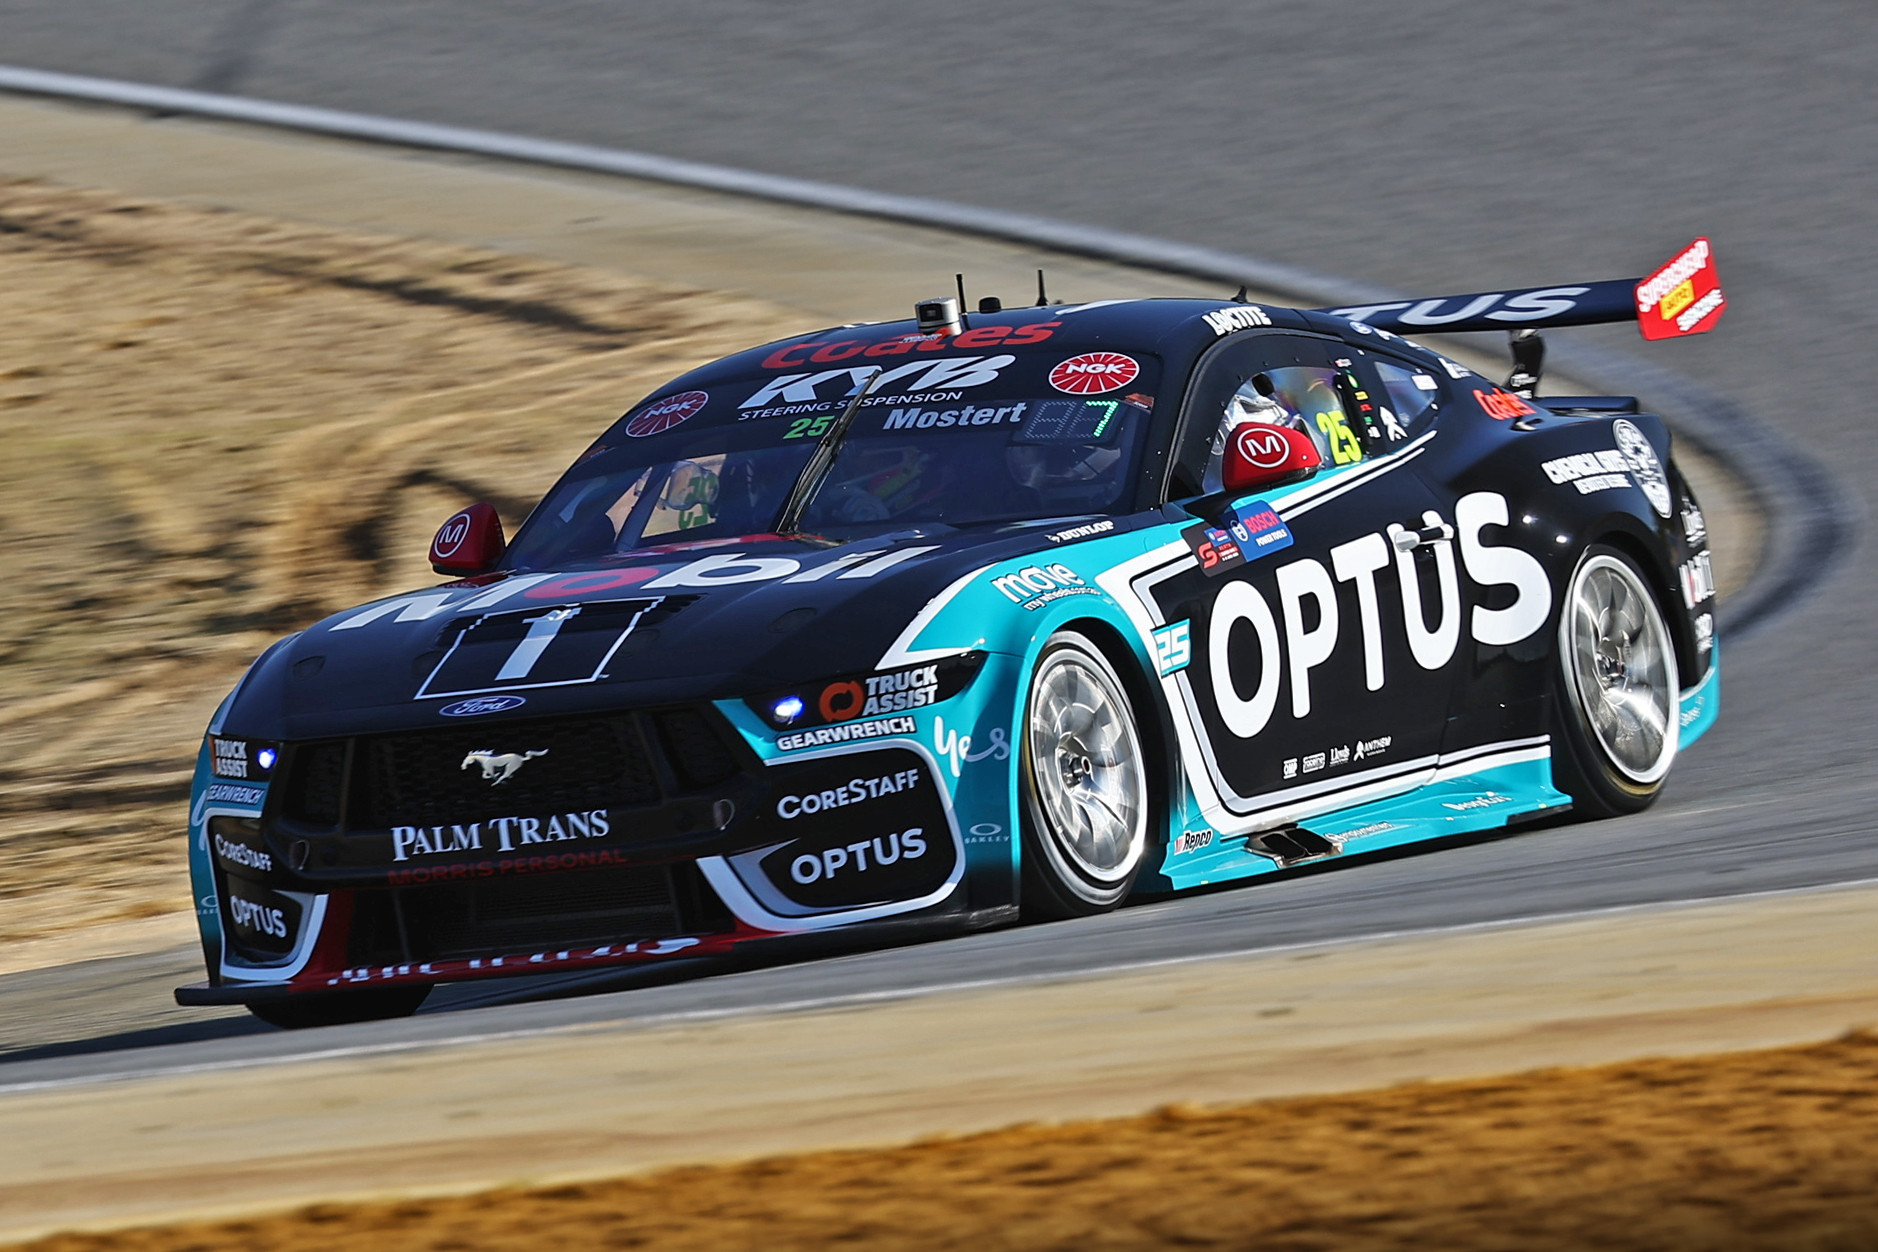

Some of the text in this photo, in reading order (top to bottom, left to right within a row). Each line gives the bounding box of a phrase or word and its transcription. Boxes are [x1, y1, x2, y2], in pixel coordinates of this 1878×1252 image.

[1202, 306, 1272, 336] LOCTITE
[737, 354, 1016, 410] KYB
[1065, 363, 1127, 374] NGK
[643, 398, 699, 420] NGK
[737, 391, 963, 422] STEERING SUSPENSION
[883, 402, 1028, 430] Mostert
[1085, 400, 1119, 438] 7
[782, 415, 836, 440] 25
[1315, 410, 1362, 465] 25
[1057, 520, 1115, 541] DUNLOP
[1243, 510, 1281, 534] BOSCH
[990, 563, 1086, 604] move
[1208, 491, 1552, 739] OPTUS
[494, 606, 582, 681] 1
[1152, 620, 1191, 677] 25
[865, 665, 938, 697] TRUCK
[452, 698, 503, 714] Ford
[862, 685, 938, 717] ASSIST
[214, 738, 247, 759] TRUCK
[776, 716, 916, 750] GEARWRENCH
[215, 757, 248, 778] ASSIST
[207, 784, 264, 805] GEARWRENCH
[390, 809, 611, 861] PALM TRANS
[1183, 829, 1213, 852] Repco
[387, 848, 628, 885] MORRIS PERSONAL
[790, 828, 928, 884] OPTUS
[231, 895, 287, 938] OPTUS
